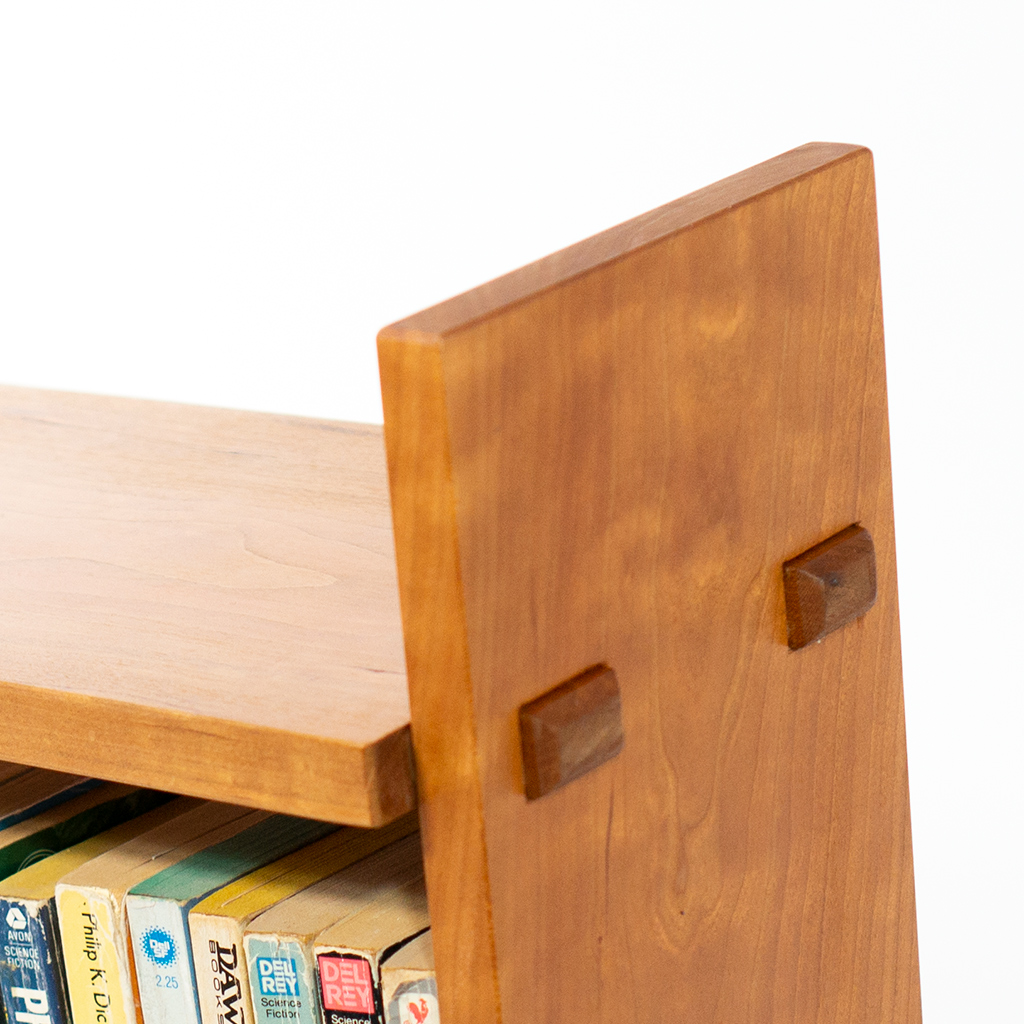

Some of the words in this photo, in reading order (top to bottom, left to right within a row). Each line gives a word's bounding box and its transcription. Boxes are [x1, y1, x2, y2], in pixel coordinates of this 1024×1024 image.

[8, 930, 33, 942] AVON
[80, 911, 102, 963] Philip
[4, 945, 39, 959] SCIENCE
[7, 957, 40, 971] FICTION
[259, 958, 297, 977] DEL
[89, 967, 108, 987] K.
[322, 960, 368, 985] DEL
[155, 974, 179, 989] 2.25
[261, 977, 300, 995] REY
[260, 997, 302, 1009] Science
[325, 984, 371, 1009] REY
[265, 1008, 301, 1019] Fiction
